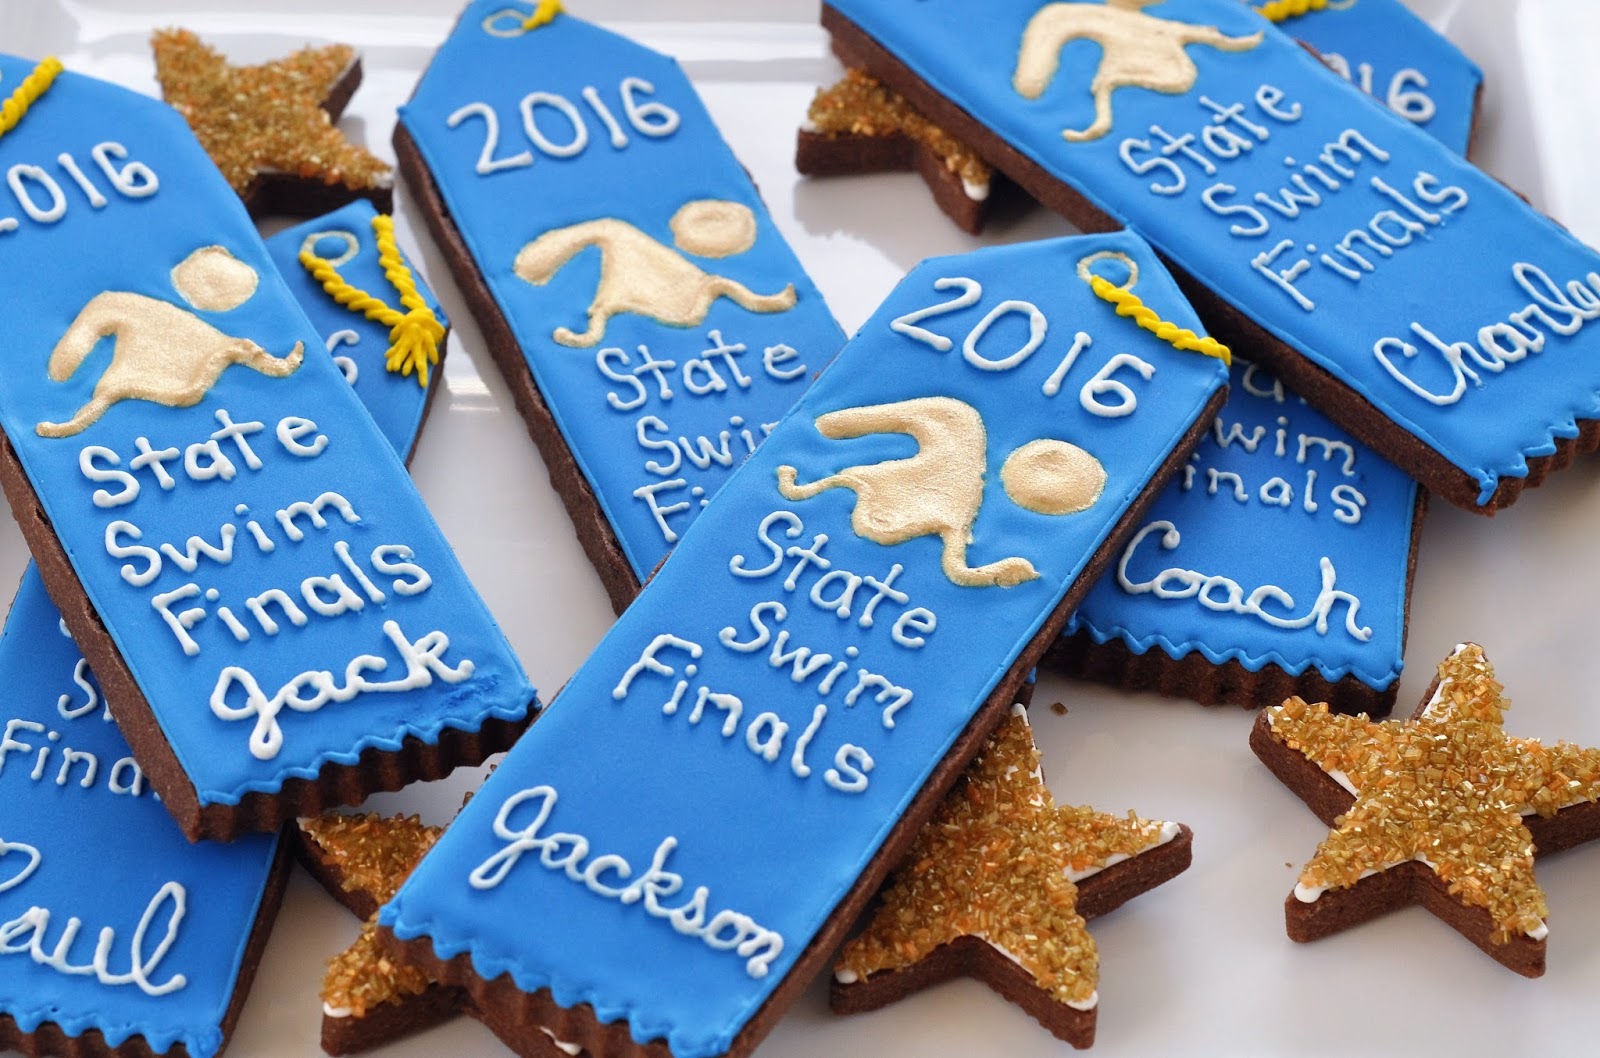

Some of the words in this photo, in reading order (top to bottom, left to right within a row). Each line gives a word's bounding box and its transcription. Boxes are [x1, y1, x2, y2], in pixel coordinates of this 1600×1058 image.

[446, 77, 681, 175] 2016
[1119, 84, 1301, 194] State
[1202, 129, 1390, 236] Swim
[0, 141, 160, 232] 016
[1251, 171, 1469, 311] Finals
[595, 329, 807, 411] State
[889, 276, 1156, 419] 2016
[1373, 262, 1600, 406] Charle
[78, 408, 330, 508] State
[1183, 452, 1368, 525] inals
[1212, 415, 1356, 477] wim
[105, 491, 361, 587] Swim
[729, 510, 938, 649] State
[1117, 520, 1374, 643] Coach
[151, 541, 433, 657] Finals
[209, 619, 476, 761] Jack
[612, 633, 876, 794] Finals
[718, 600, 914, 730] Swim
[0, 718, 161, 800] Fina
[469, 785, 786, 979] Jackson
